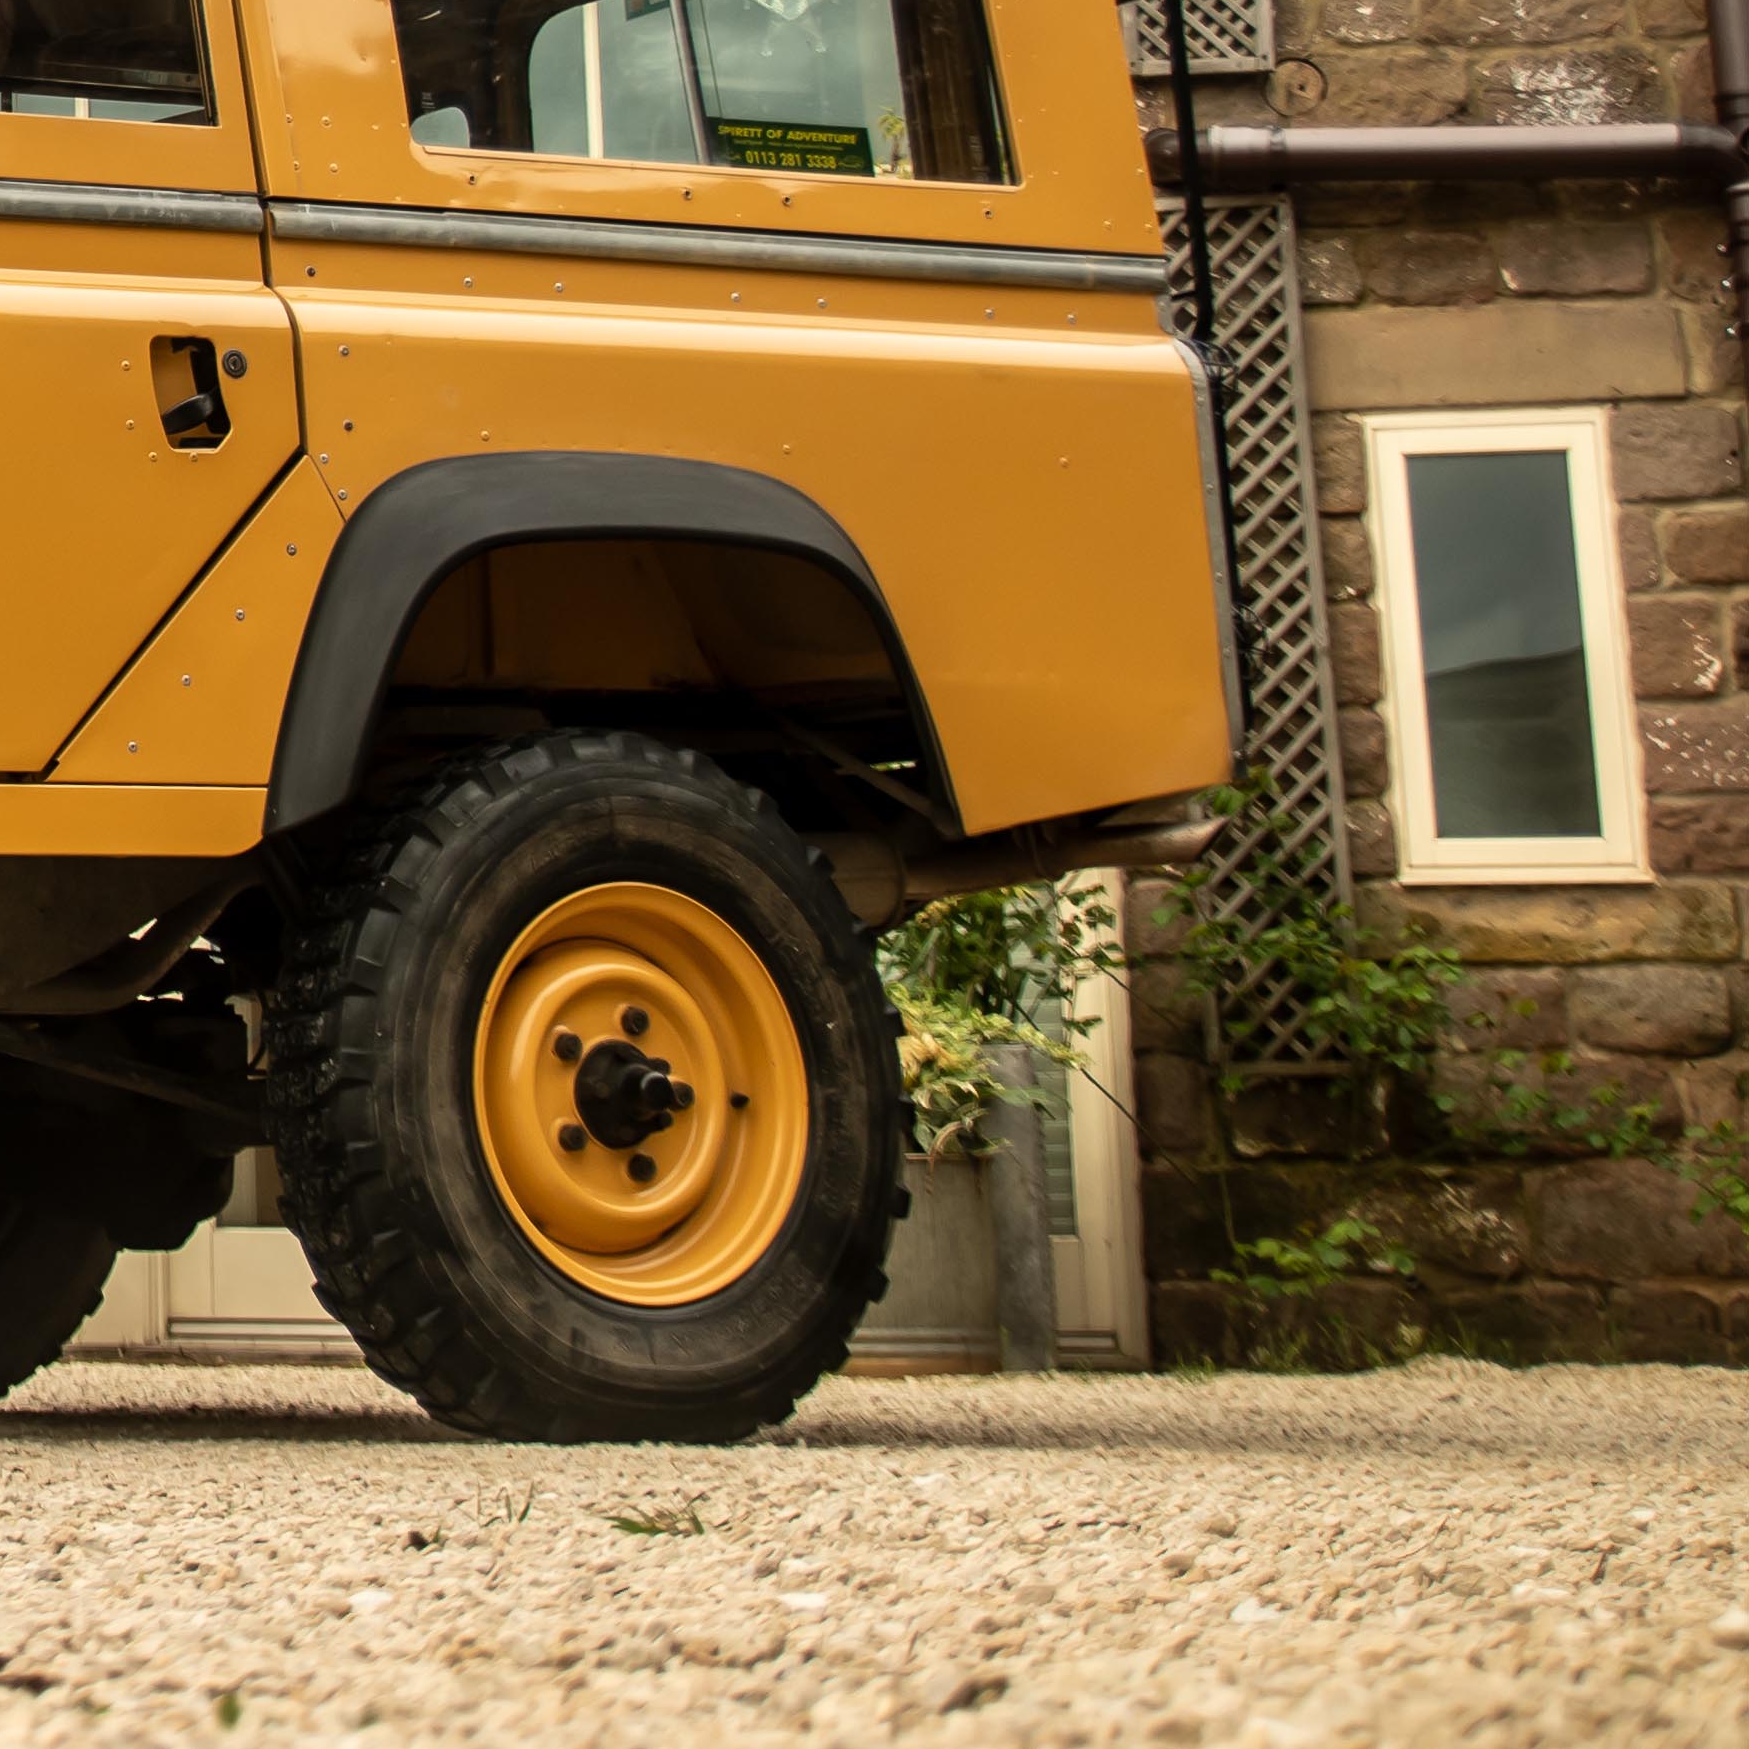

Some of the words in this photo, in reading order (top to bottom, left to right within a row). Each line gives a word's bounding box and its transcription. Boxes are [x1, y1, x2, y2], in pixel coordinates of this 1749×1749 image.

[766, 129, 783, 140] OF
[786, 130, 857, 145] ADVENTURE
[745, 150, 777, 165] 0113
[779, 152, 802, 167] 281
